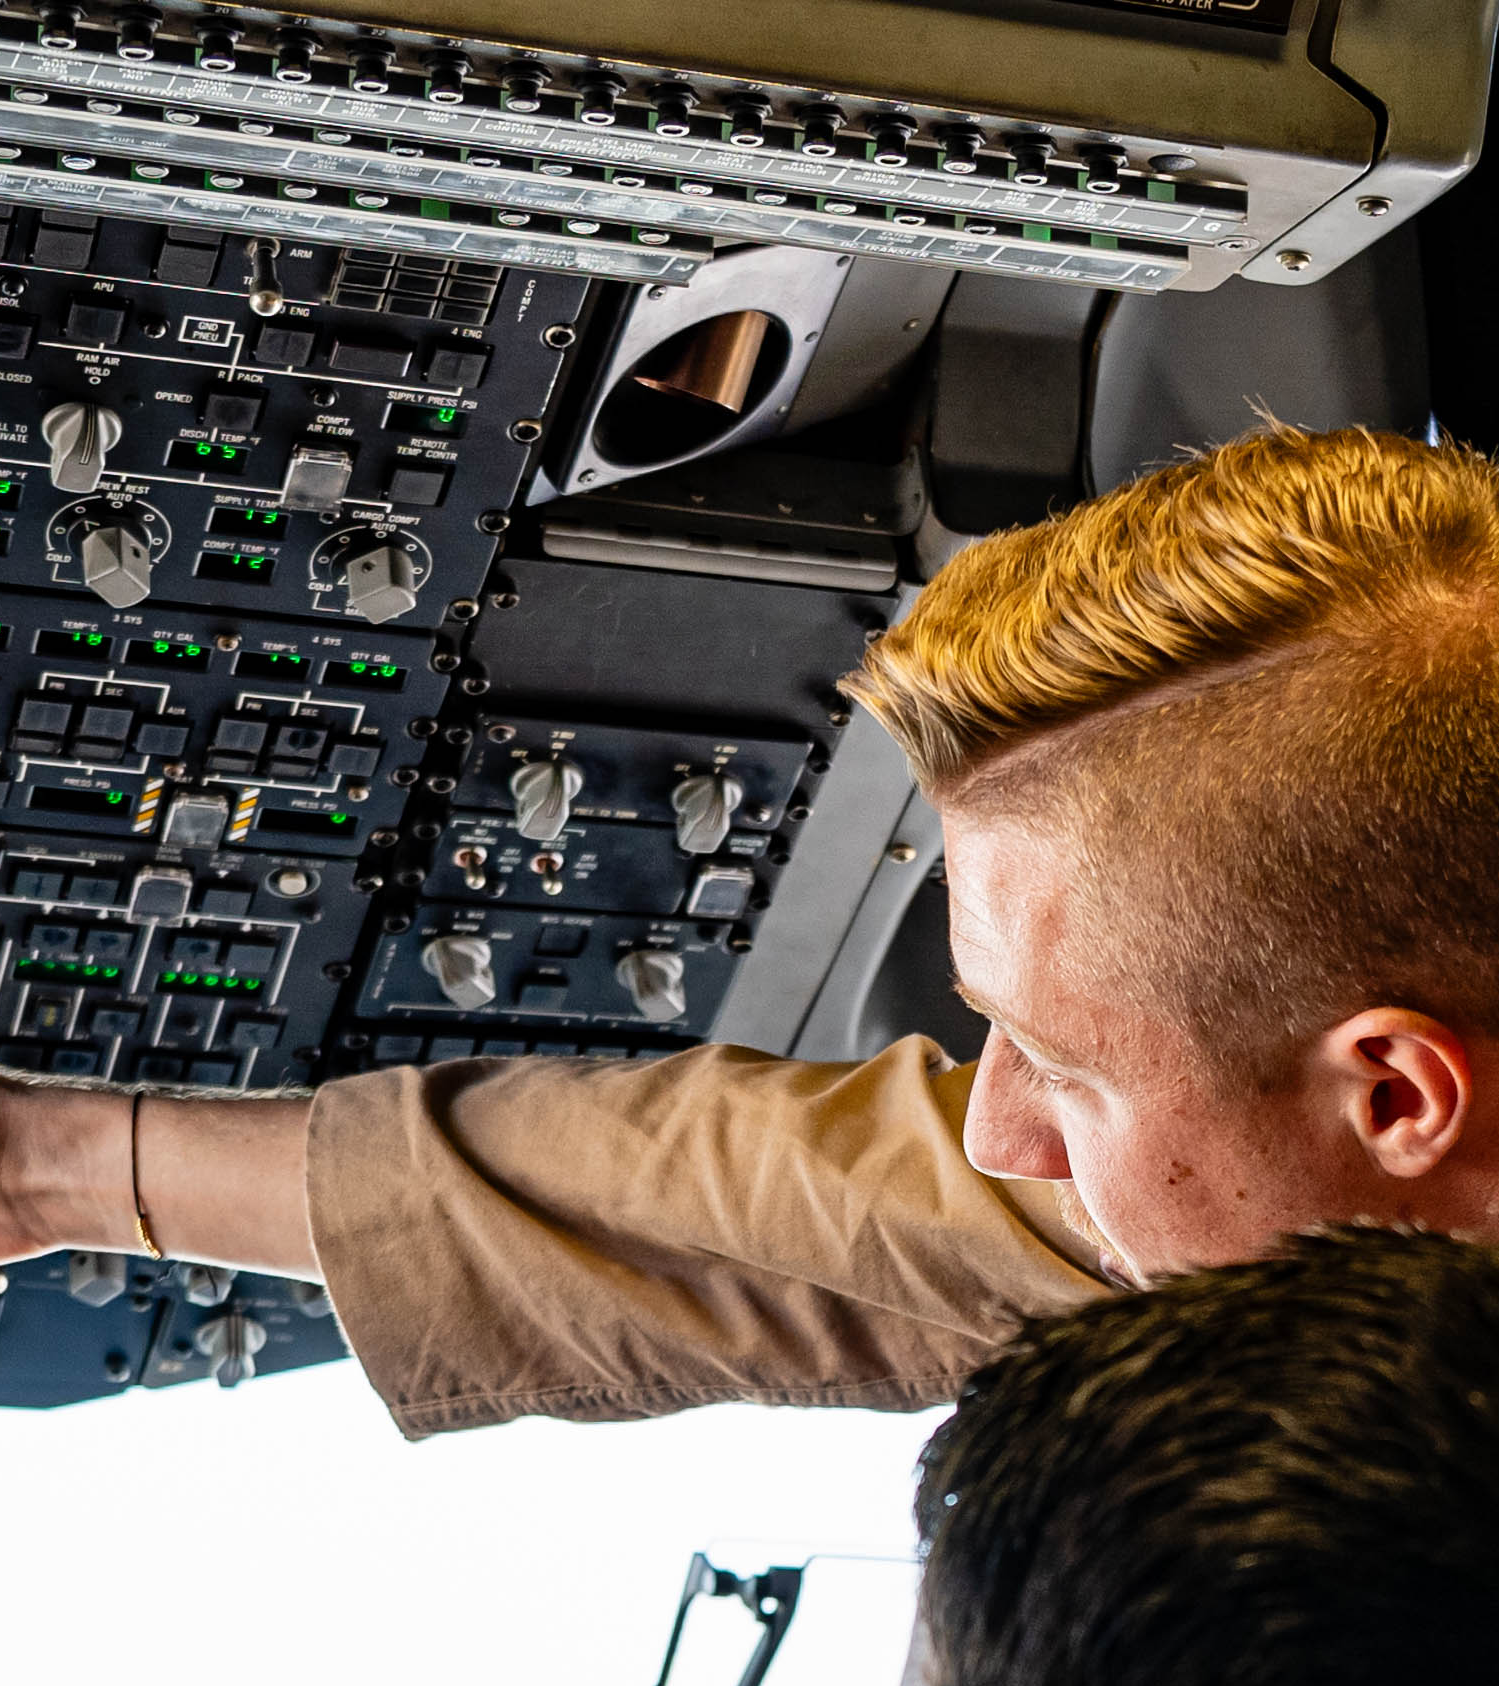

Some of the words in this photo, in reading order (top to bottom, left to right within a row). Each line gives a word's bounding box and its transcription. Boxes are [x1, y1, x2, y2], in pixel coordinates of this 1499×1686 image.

[290, 248, 313, 260] ARM
[93, 282, 114, 293] APU
[0, 297, 20, 308] ISOL
[290, 305, 311, 318] ENG
[198, 321, 219, 332] GND
[193, 330, 219, 342] PNEU
[451, 327, 459, 336] 4
[462, 328, 483, 340] ENG
[76, 353, 100, 365] RAM
[103, 356, 121, 367] AIR
[84, 366, 111, 377] HOLD
[237, 372, 264, 384] PACK
[155, 391, 193, 404] OPENED
[387, 390, 425, 403] SUPPLY
[427, 395, 460, 408] PRESS
[462, 399, 479, 410] PSI
[316, 414, 351, 426] COMPT
[15, 424, 28, 434] TO
[307, 423, 325, 433] AIR
[327, 425, 355, 437] FLOW
[179, 429, 209, 440] DISCH
[220, 432, 247, 443] TEMP
[410, 438, 449, 450] REMOTE
[397, 446, 423, 458] TEMP
[425, 449, 458, 462] CONTR
[125, 484, 150, 495] REST
[106, 491, 133, 502] AUTO
[214, 494, 251, 507] SUPPLY
[352, 510, 385, 523] CARGO
[387, 514, 422, 525] COMPT
[370, 522, 398, 533] AUTO
[203, 540, 237, 552] COMPT
[240, 544, 267, 554] TEMP
[45, 553, 72, 564] COLD
[308, 581, 333, 592] COLD
[123, 616, 143, 625] SYS
[322, 637, 342, 647] SYS
